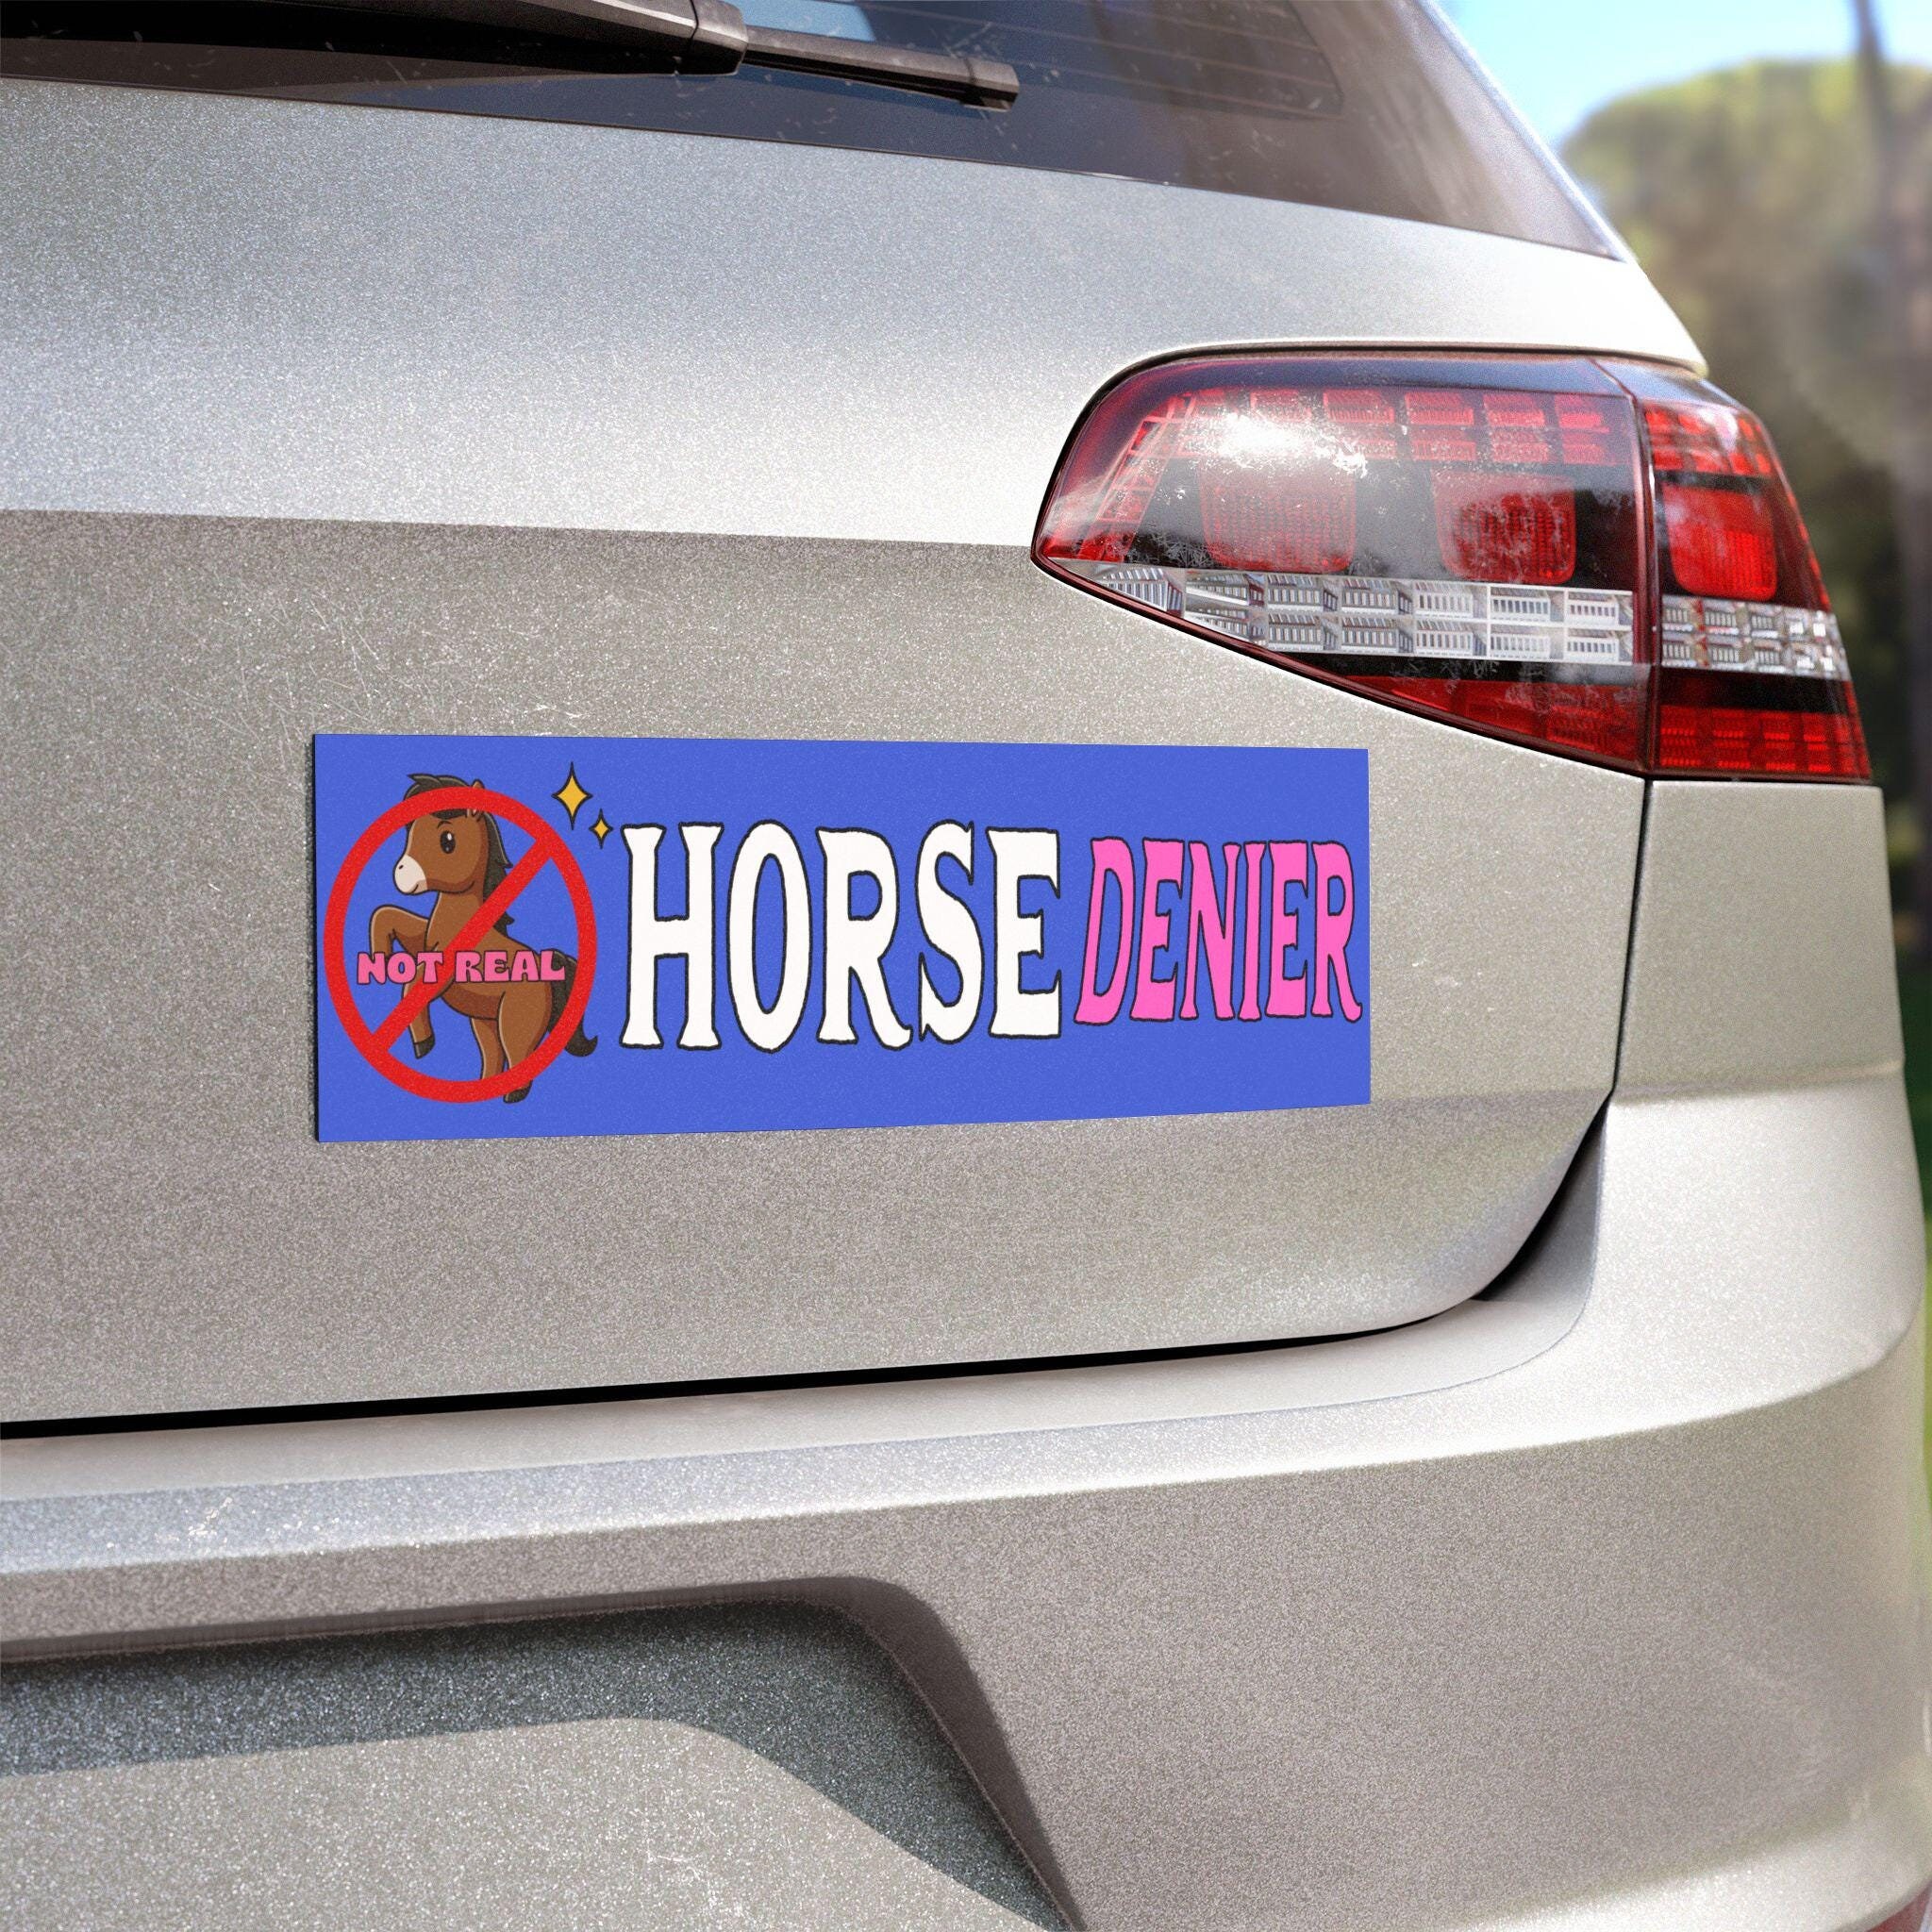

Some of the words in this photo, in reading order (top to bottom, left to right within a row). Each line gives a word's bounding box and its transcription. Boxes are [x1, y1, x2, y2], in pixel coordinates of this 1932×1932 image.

[357, 951, 443, 985] NOT
[455, 950, 567, 983] REAL
[619, 819, 1062, 1054] HORSE
[1074, 837, 1363, 1025] DENIER
